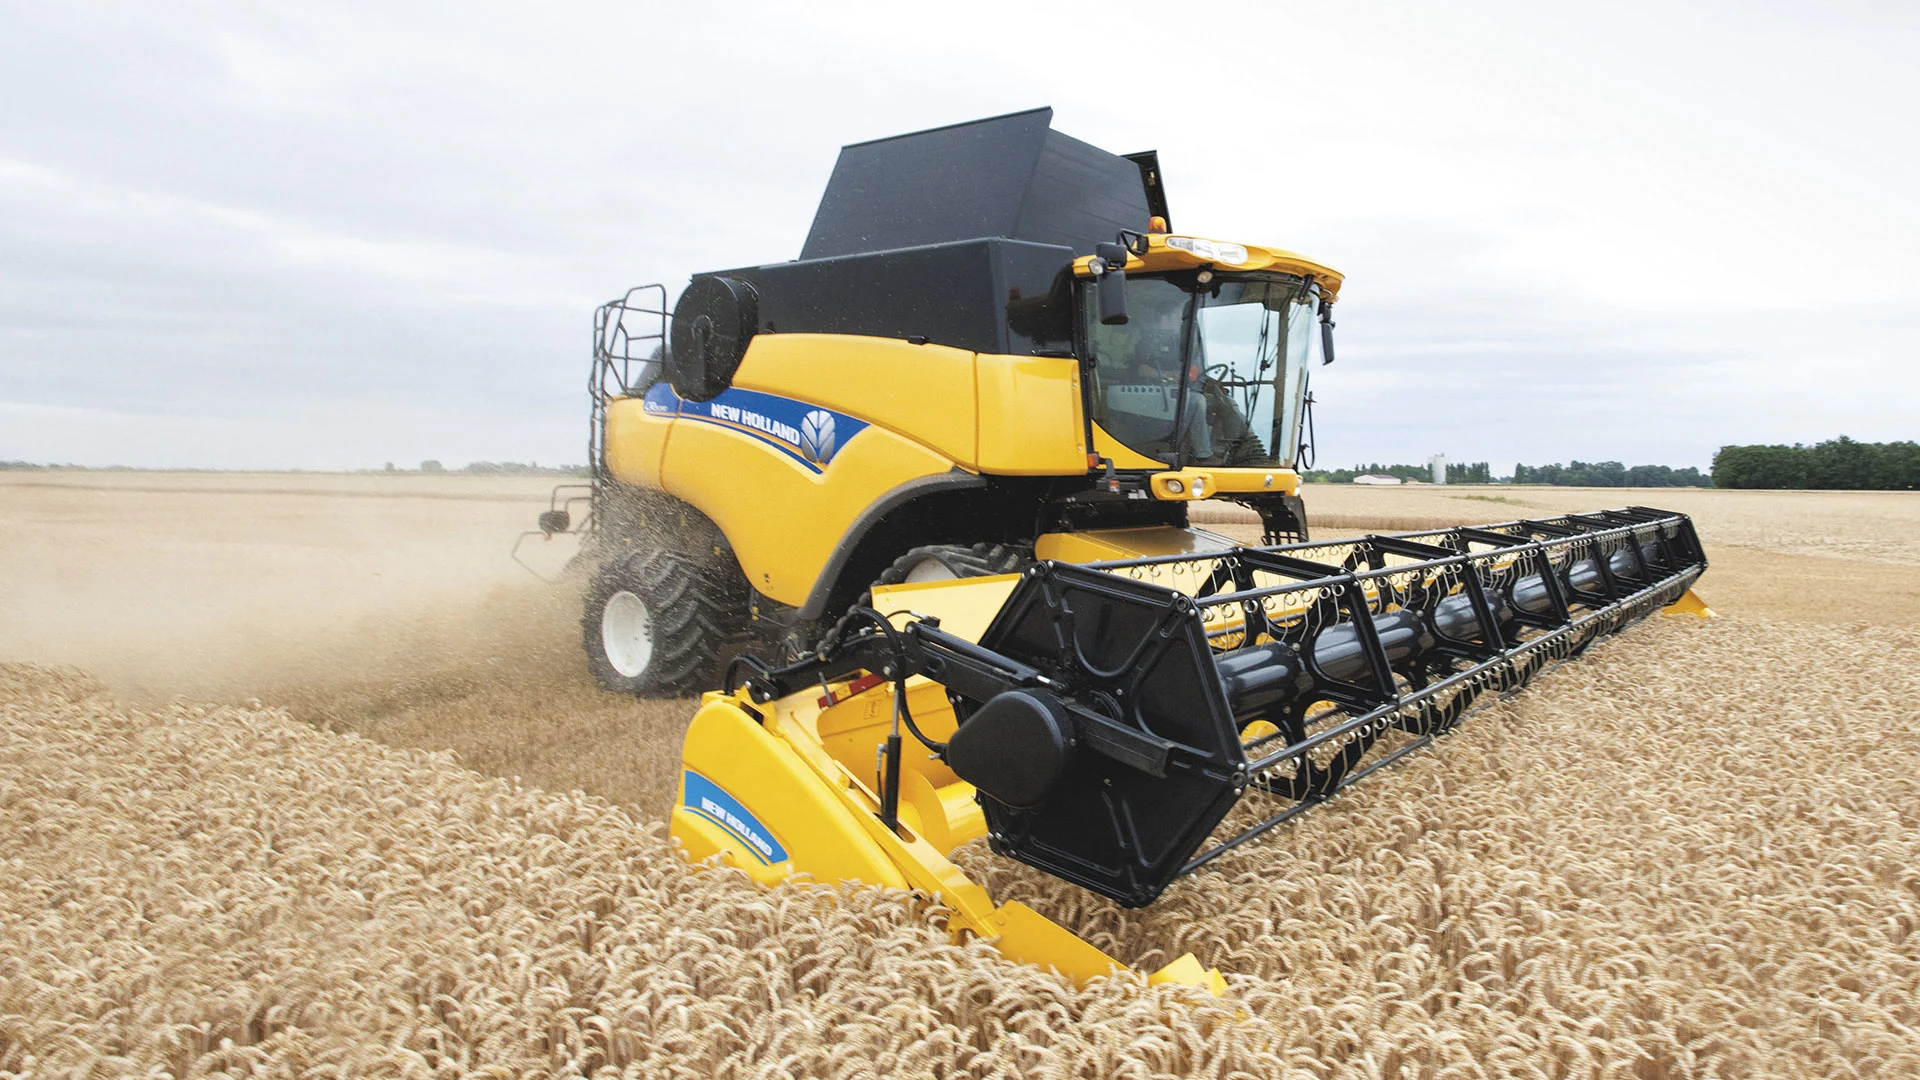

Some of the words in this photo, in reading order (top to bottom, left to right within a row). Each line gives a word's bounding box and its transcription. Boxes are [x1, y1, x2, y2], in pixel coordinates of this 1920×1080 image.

[711, 403, 741, 423] NEW
[742, 409, 800, 446] HOLLAND
[701, 796, 727, 821] NEW
[725, 812, 773, 857] HOLLAND
